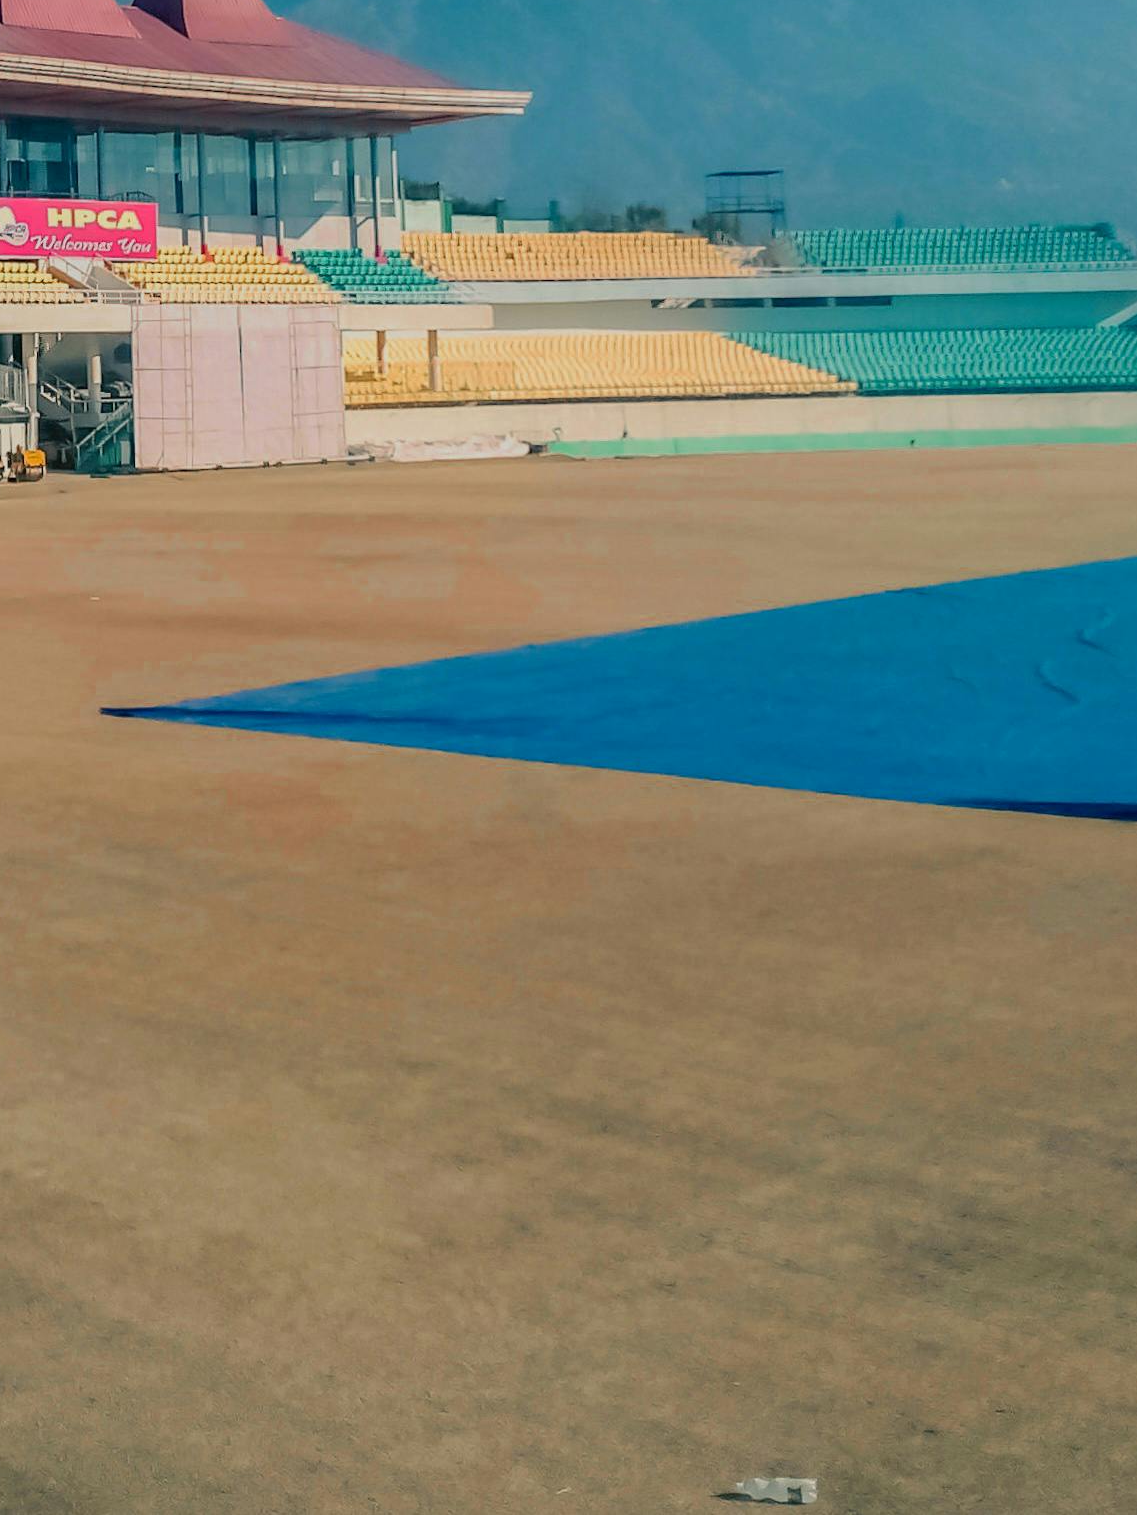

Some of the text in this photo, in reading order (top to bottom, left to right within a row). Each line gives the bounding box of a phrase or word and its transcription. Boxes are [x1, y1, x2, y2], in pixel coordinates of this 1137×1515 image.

[47, 207, 142, 231] HPCA
[30, 234, 152, 255] Welcomes You
